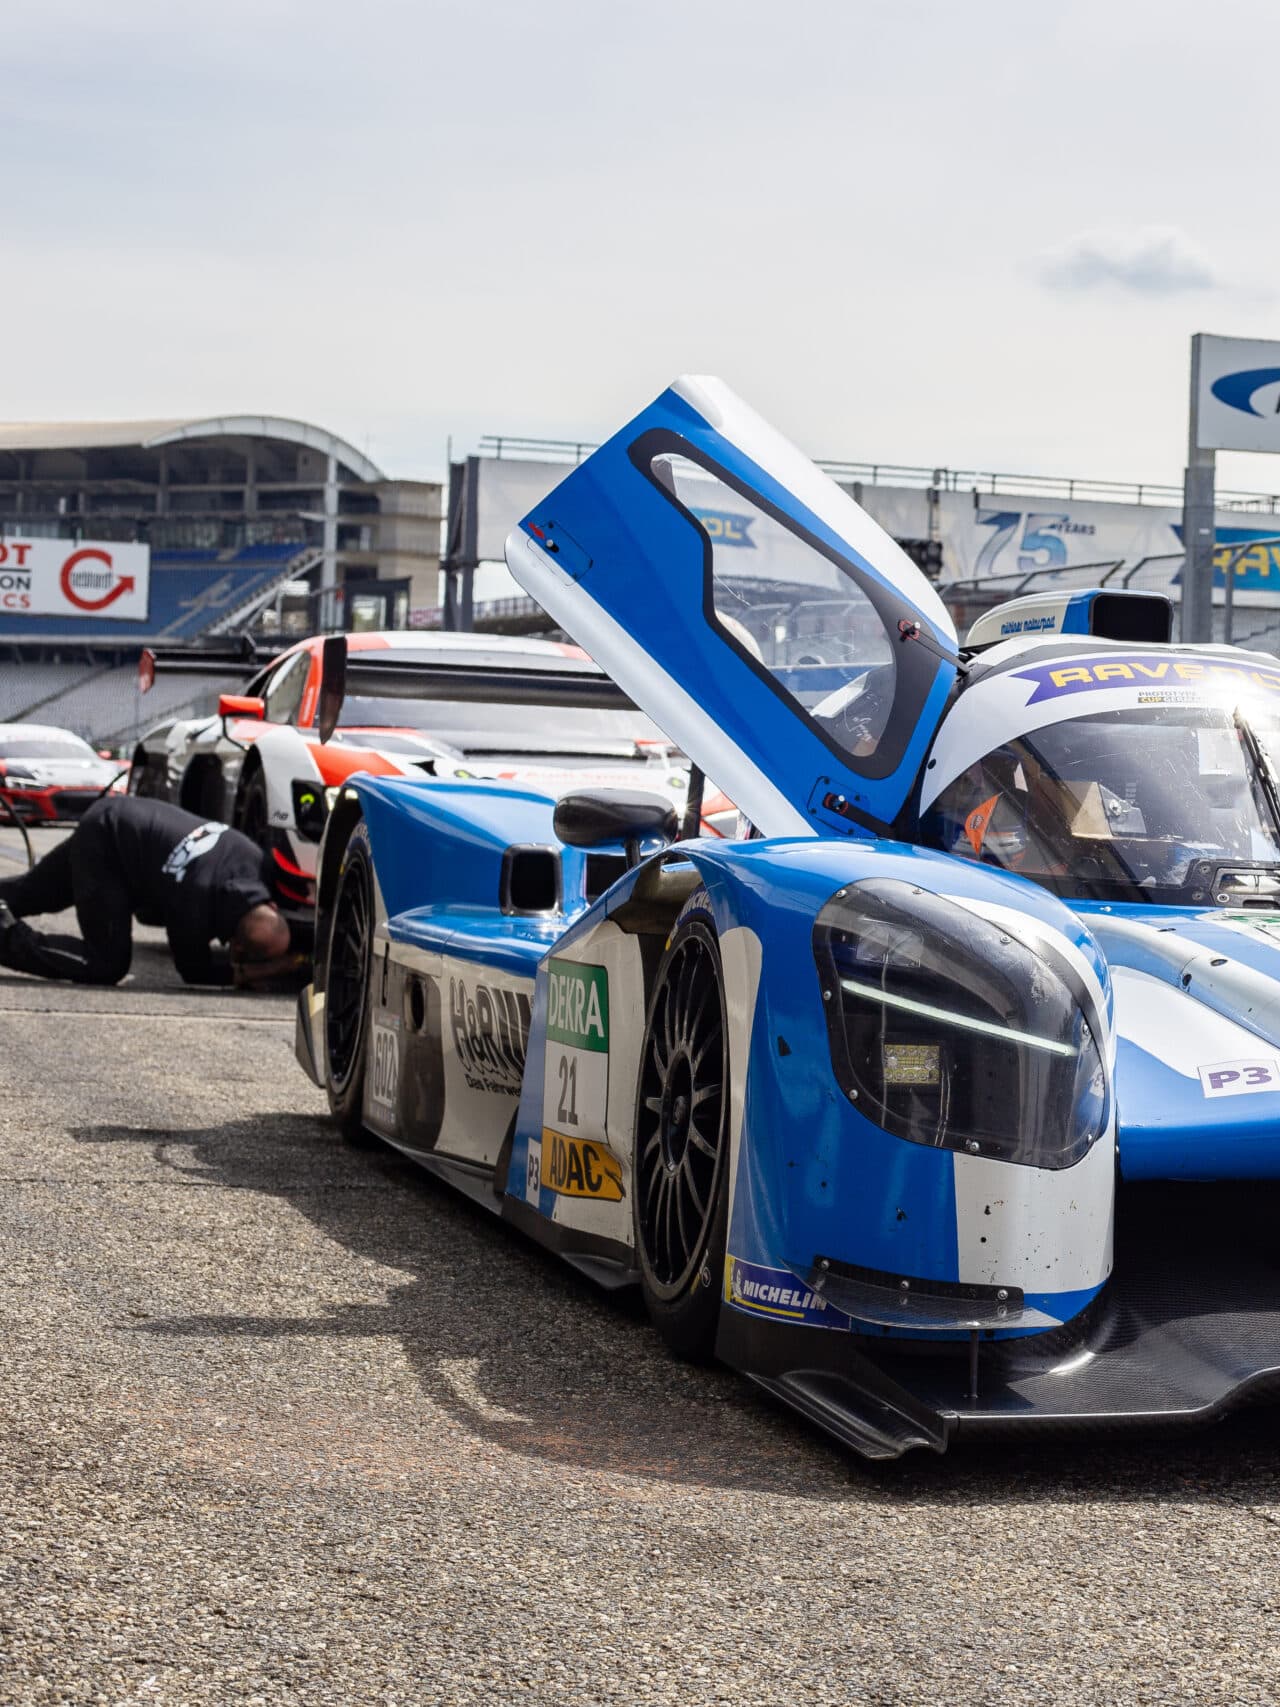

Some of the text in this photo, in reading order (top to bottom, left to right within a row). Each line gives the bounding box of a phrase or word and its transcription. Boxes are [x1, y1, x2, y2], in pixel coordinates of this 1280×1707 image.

[975, 510, 1070, 578] 75
[547, 973, 605, 1038] DEKRA
[557, 1055, 579, 1127] 21
[1208, 1066, 1273, 1090] P3
[528, 1153, 540, 1192] P3
[550, 1135, 603, 1193] ADAC
[743, 1279, 828, 1312] MICHELIN
